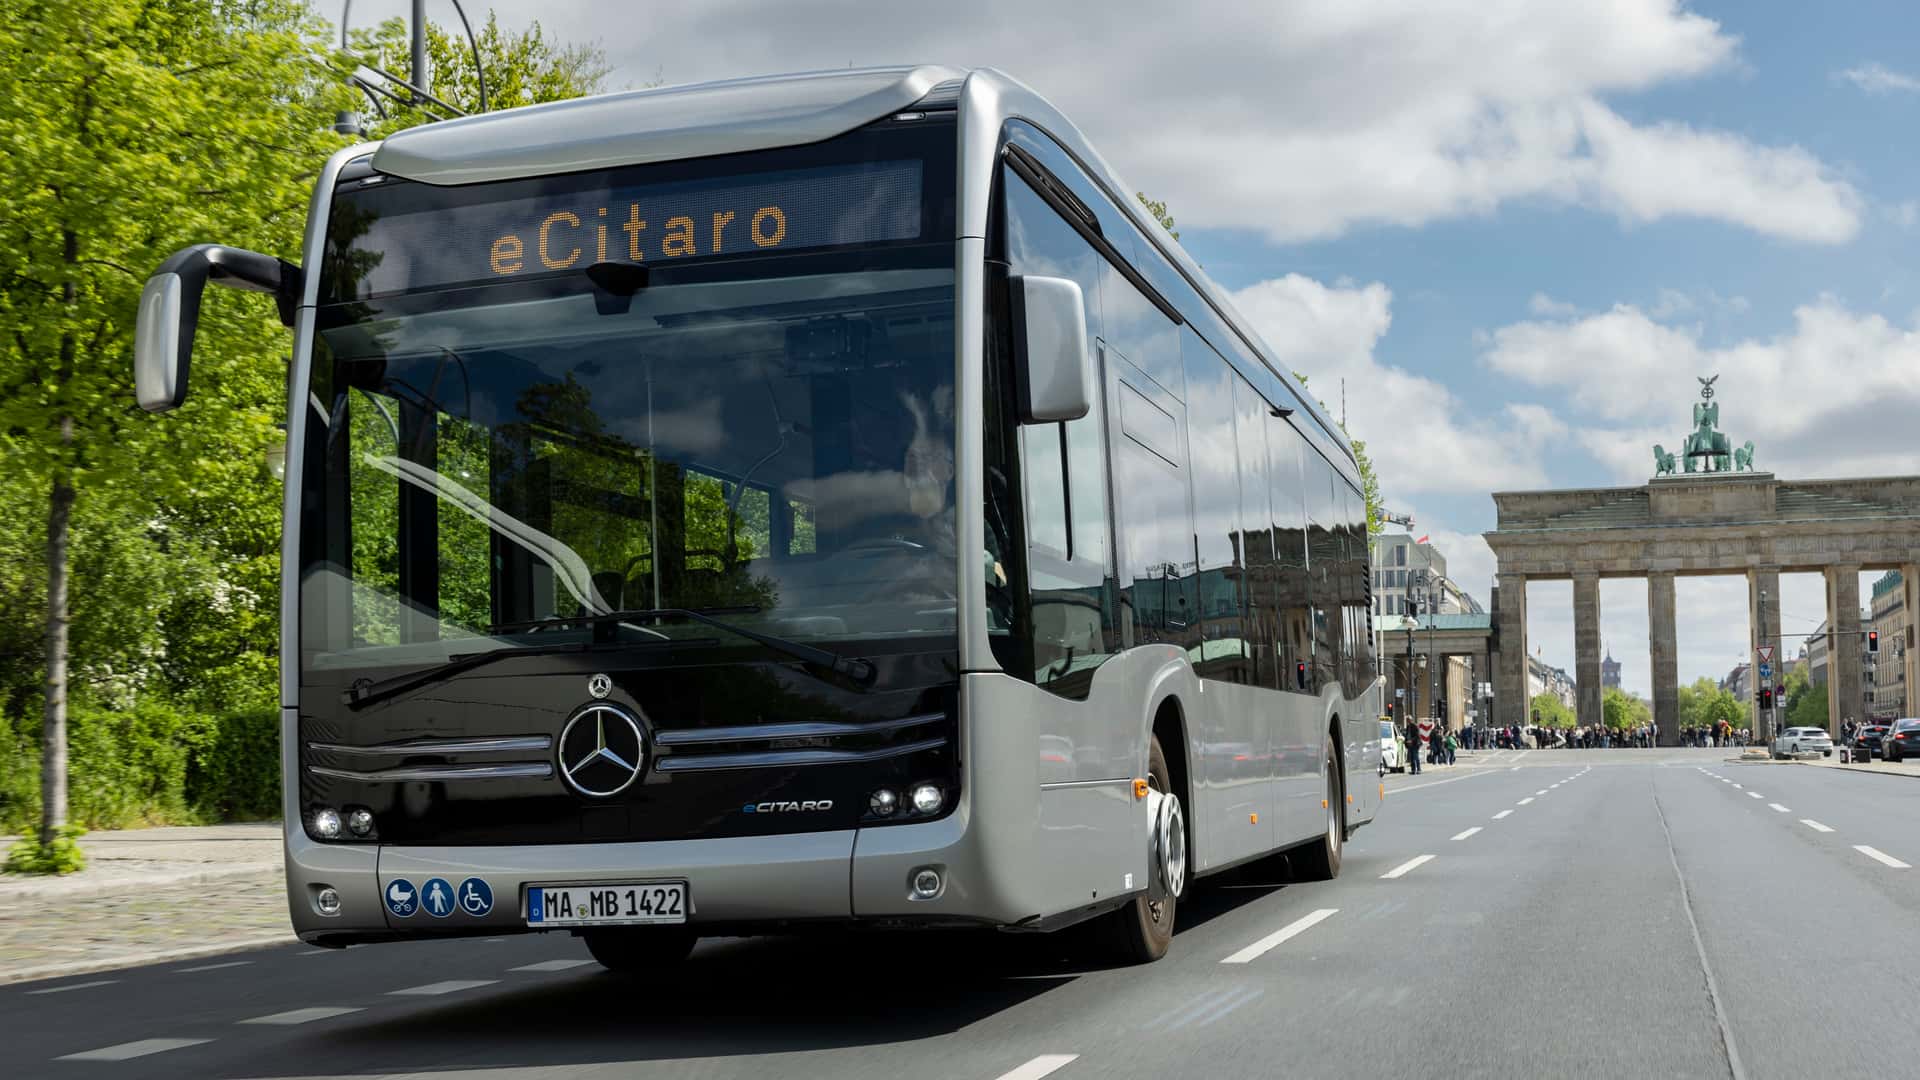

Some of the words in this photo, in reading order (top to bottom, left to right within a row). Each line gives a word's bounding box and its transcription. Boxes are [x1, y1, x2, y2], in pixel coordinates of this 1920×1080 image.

[490, 203, 786, 274] eCitaro
[743, 800, 833, 813] eCITARO
[545, 891, 573, 918] MA
[590, 889, 619, 917] MB
[625, 888, 682, 916] 1422
